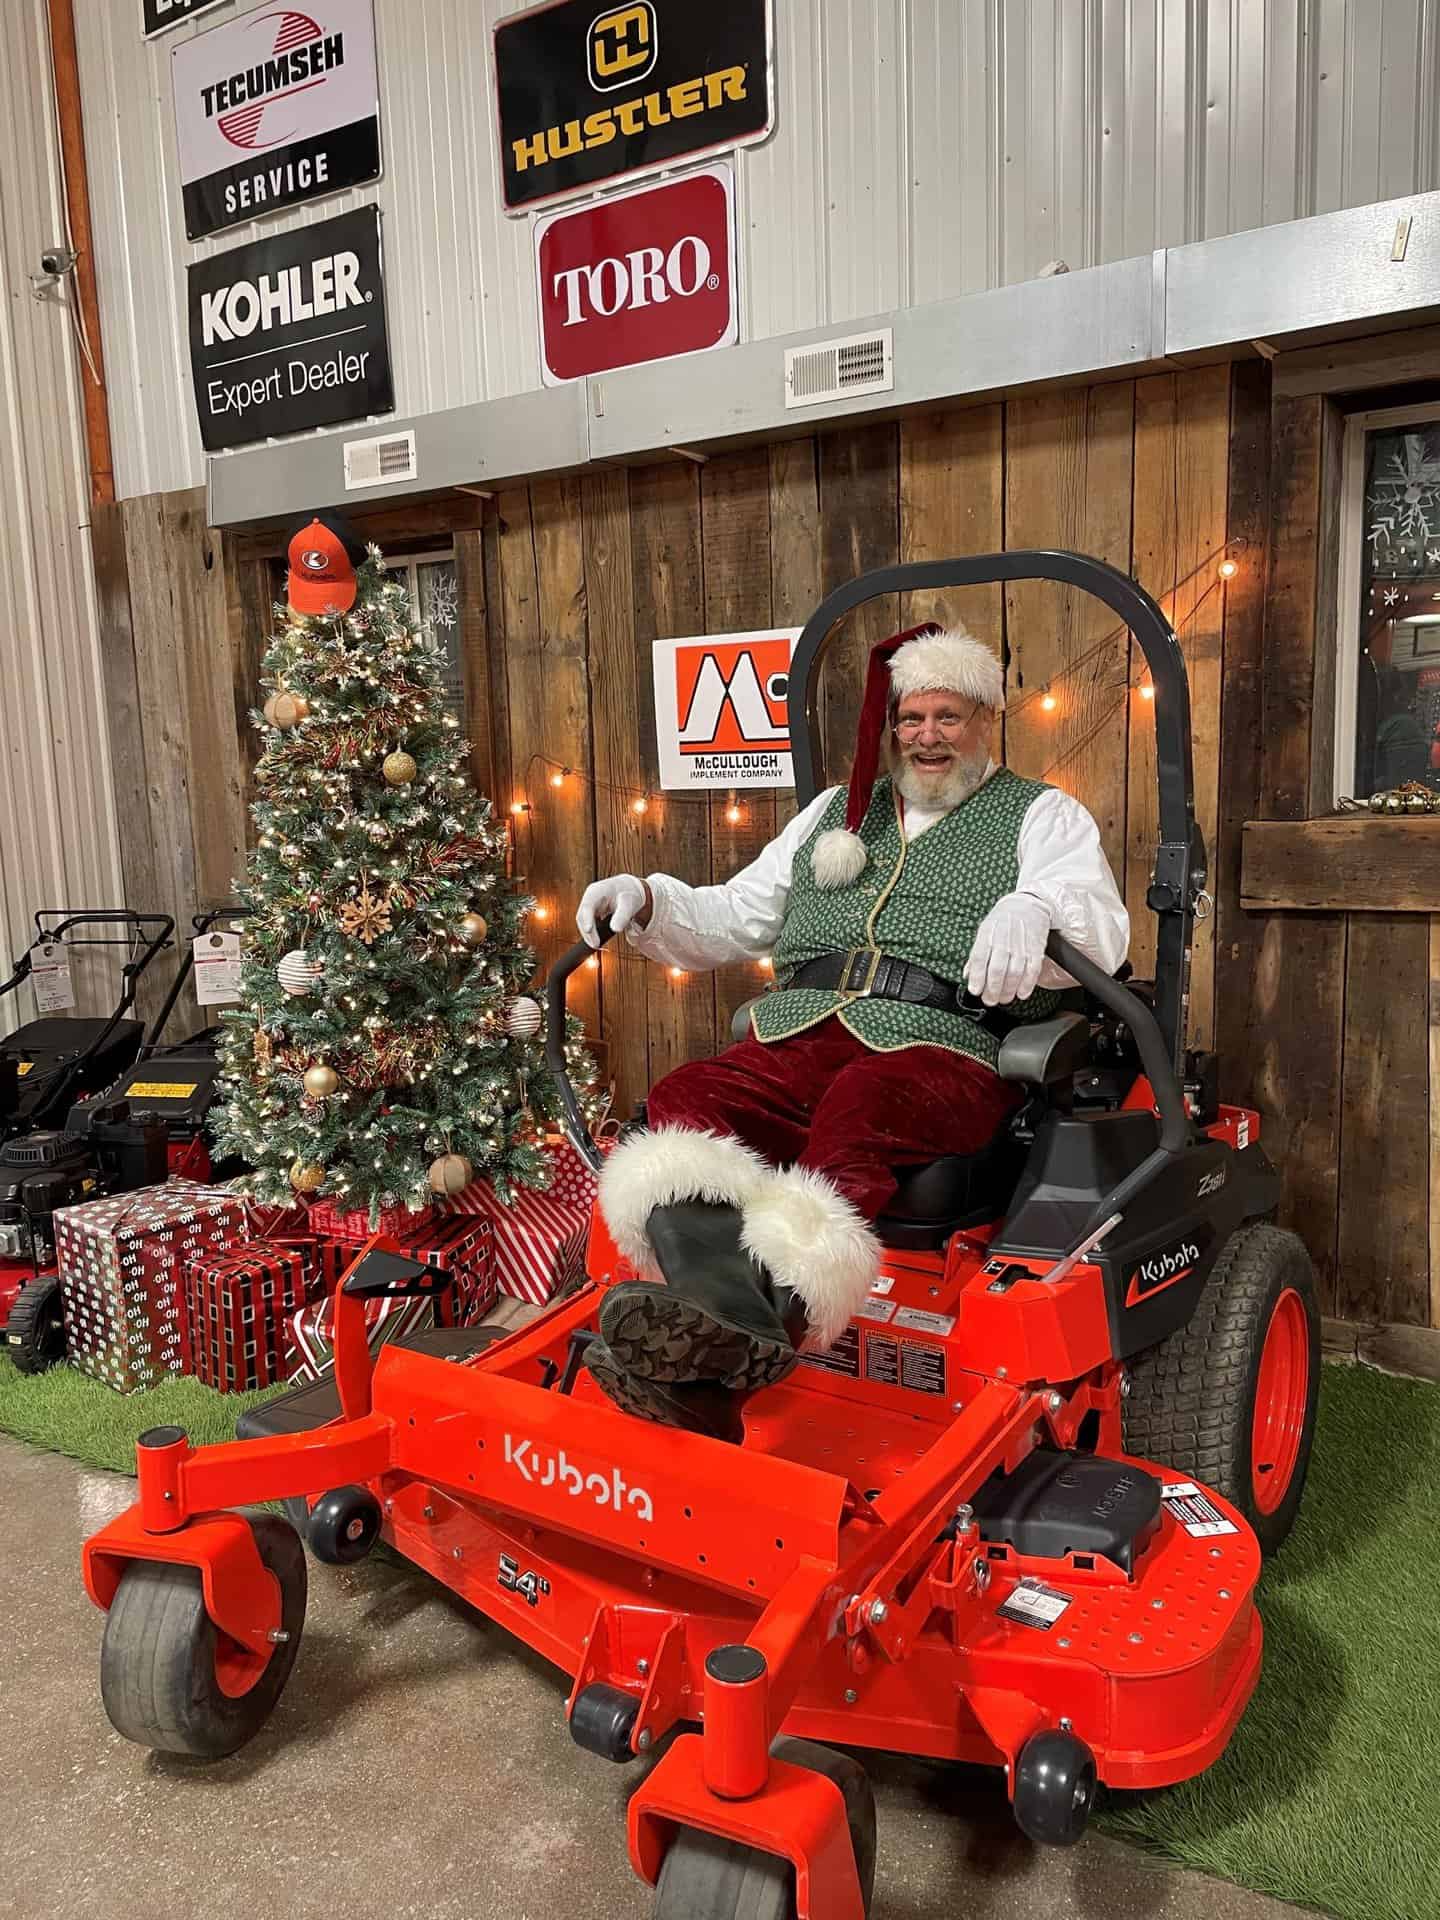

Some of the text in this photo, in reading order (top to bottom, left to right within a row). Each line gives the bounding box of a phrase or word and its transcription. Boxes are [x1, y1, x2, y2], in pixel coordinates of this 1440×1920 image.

[200, 33, 344, 117] TECUMSEH
[512, 65, 747, 172] HUSTLER
[225, 152, 328, 213] SERVICE
[207, 350, 369, 416] Expert Dealer
[690, 769, 783, 779] IMPLEMENT COMPANY
[695, 755, 778, 769] McCULLOUGH
[1140, 1243, 1200, 1281] Kubota
[504, 1433, 653, 1522] Kubota
